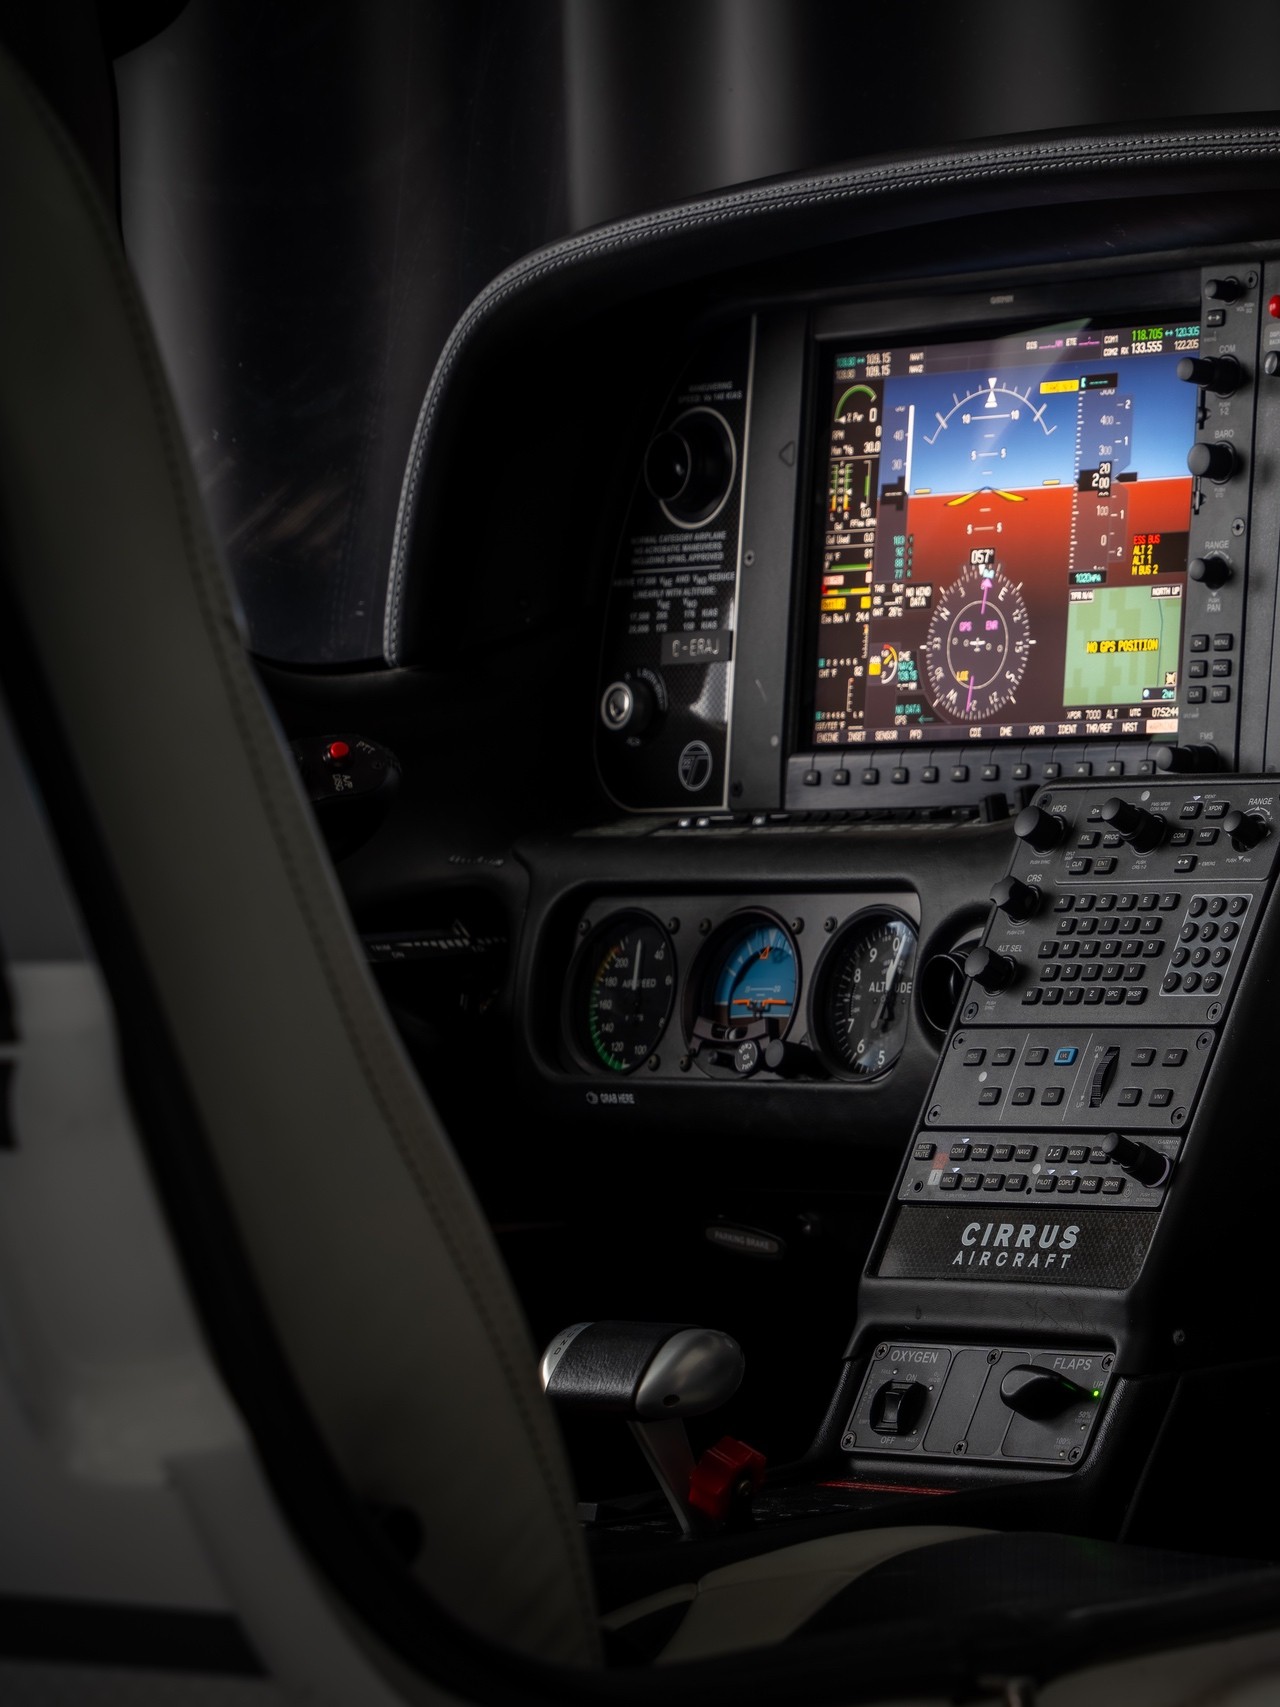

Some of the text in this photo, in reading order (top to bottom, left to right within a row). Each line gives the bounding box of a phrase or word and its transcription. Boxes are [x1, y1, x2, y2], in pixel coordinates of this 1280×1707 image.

[1132, 328, 1162, 341] 118.705
[1132, 341, 1162, 353] 133.555
[1219, 344, 1235, 353] COM
[1214, 430, 1234, 439] BARO
[1134, 534, 1160, 544] ESS BUS
[1133, 544, 1152, 555] ALT 2
[1205, 540, 1229, 549] RANGE
[1133, 556, 1145, 565] ALT
[1139, 566, 1151, 575] BUS
[1153, 565, 1158, 574] 2
[1207, 603, 1220, 612] PAN
[1087, 638, 1158, 653] NO GPS POSITION
[1086, 709, 1101, 719] 7000
[1106, 709, 1118, 718] ALT
[1058, 724, 1077, 734] IDENT
[1248, 797, 1273, 806] RANGE
[1052, 804, 1067, 813] HDG
[1071, 860, 1083, 868] CLR
[1027, 874, 1042, 882] CRS
[997, 944, 1023, 953] ALT SEL
[869, 981, 913, 993] ALTUDE
[600, 1092, 635, 1104] GRAB HERE
[961, 1222, 1081, 1250] CIRRUS
[952, 1250, 1072, 1269] AIRCRAFT
[890, 1350, 939, 1364] OXYGEN
[1053, 1358, 1093, 1371] FLAPS
[880, 1436, 895, 1445] OFF
